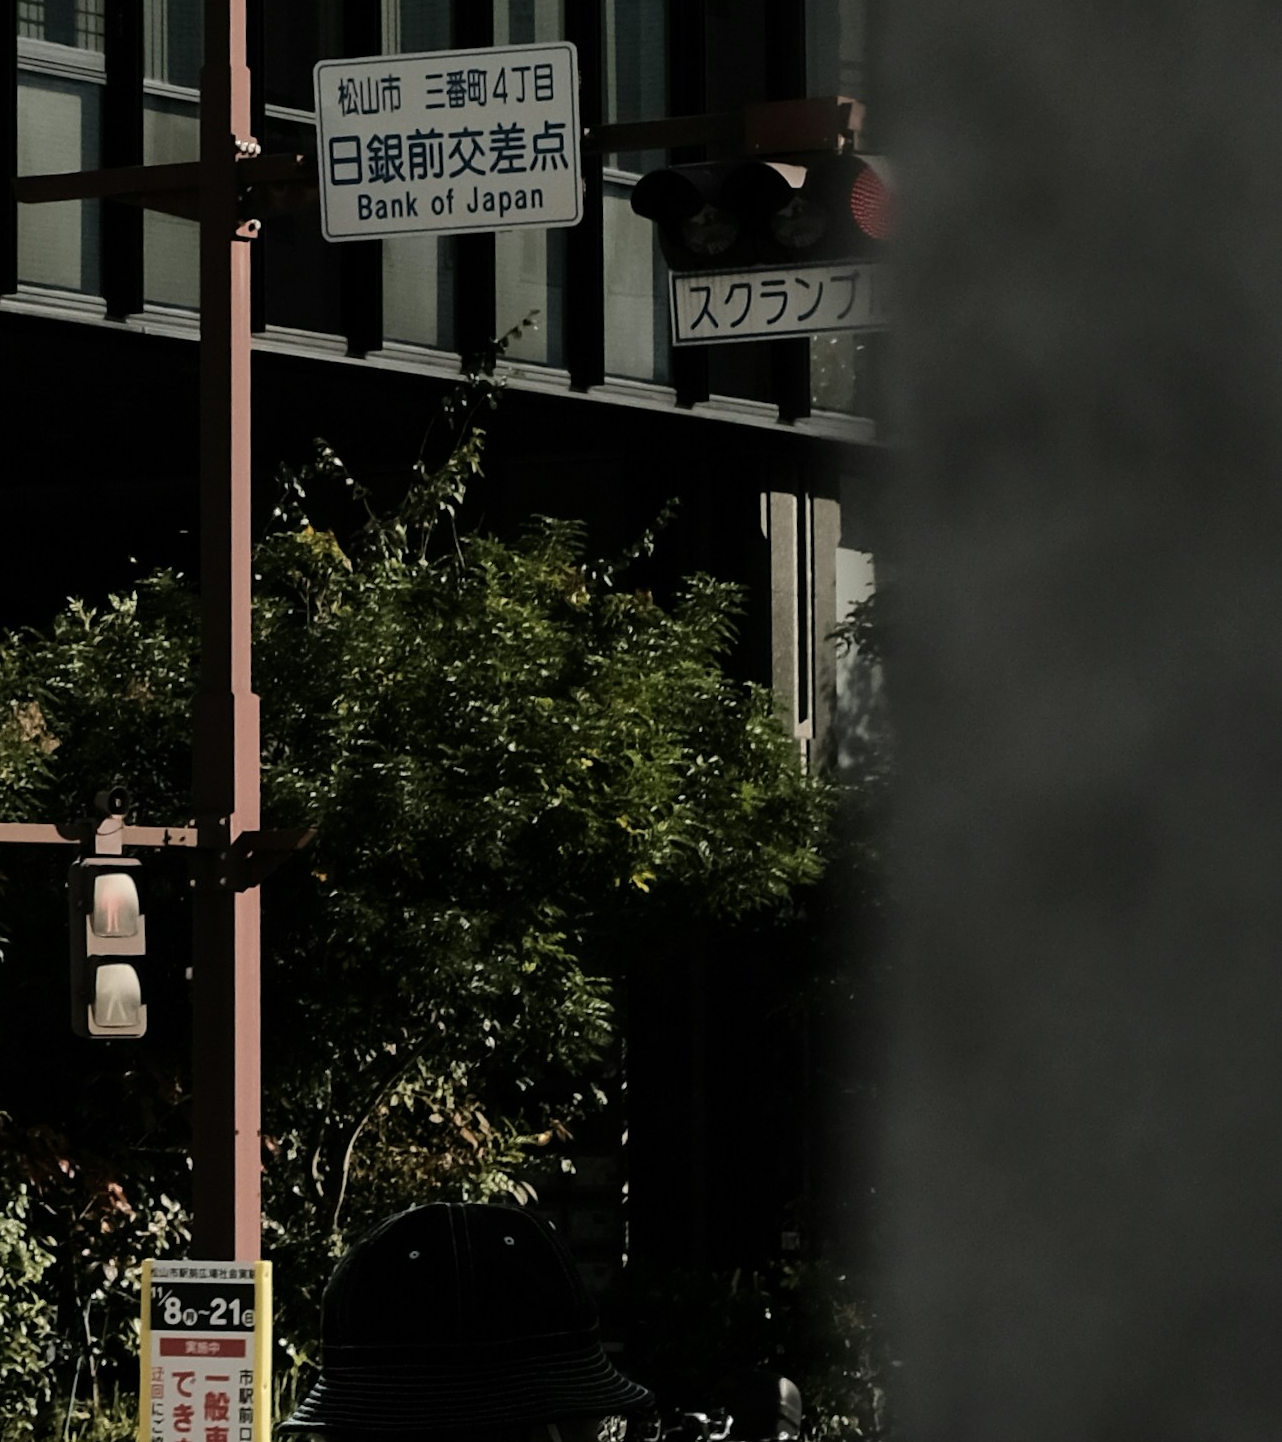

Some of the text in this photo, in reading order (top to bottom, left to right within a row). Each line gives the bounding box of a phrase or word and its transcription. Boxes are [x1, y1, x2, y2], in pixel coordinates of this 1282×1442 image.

[337, 63, 554, 117] 松山市 三番町4丁目
[328, 119, 570, 186] 日銀前交差点
[357, 185, 544, 221] Bank of Japan
